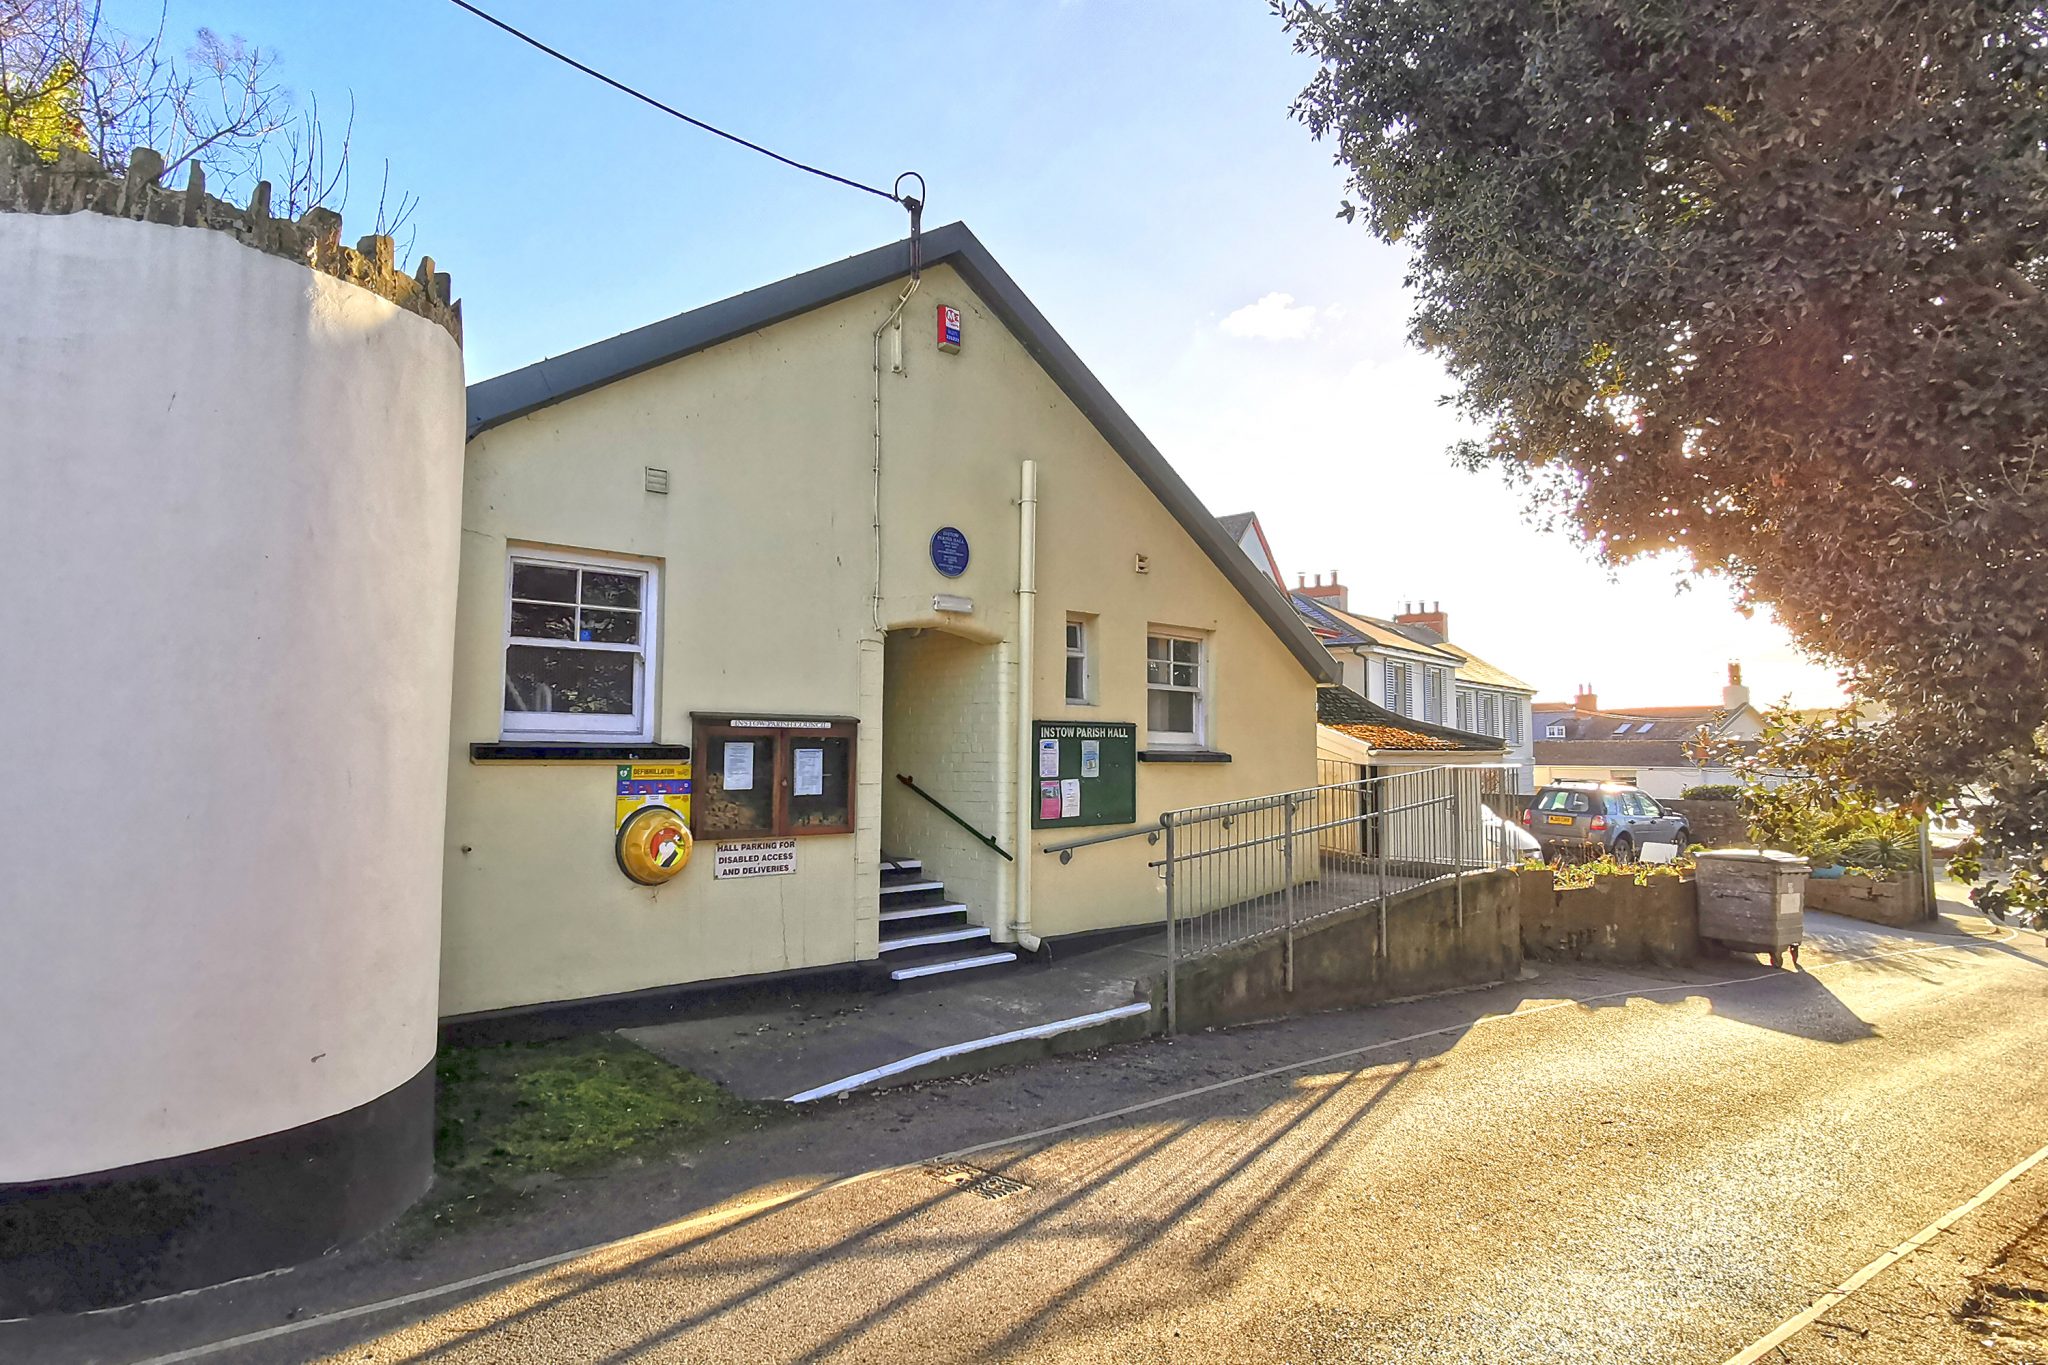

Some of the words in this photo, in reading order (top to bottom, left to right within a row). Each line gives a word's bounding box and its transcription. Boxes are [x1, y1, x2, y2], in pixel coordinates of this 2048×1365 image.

[1041, 727, 1075, 738] INSTOW
[1076, 727, 1106, 738] PARISH
[1107, 728, 1128, 738] HALL
[717, 844, 739, 852] HALL
[741, 842, 777, 851] PARKING
[779, 841, 795, 849] FOR
[718, 855, 760, 864] DISABLED
[761, 852, 794, 862] ACCESS
[722, 868, 740, 876] AND
[742, 864, 790, 874] DELIVERIES
